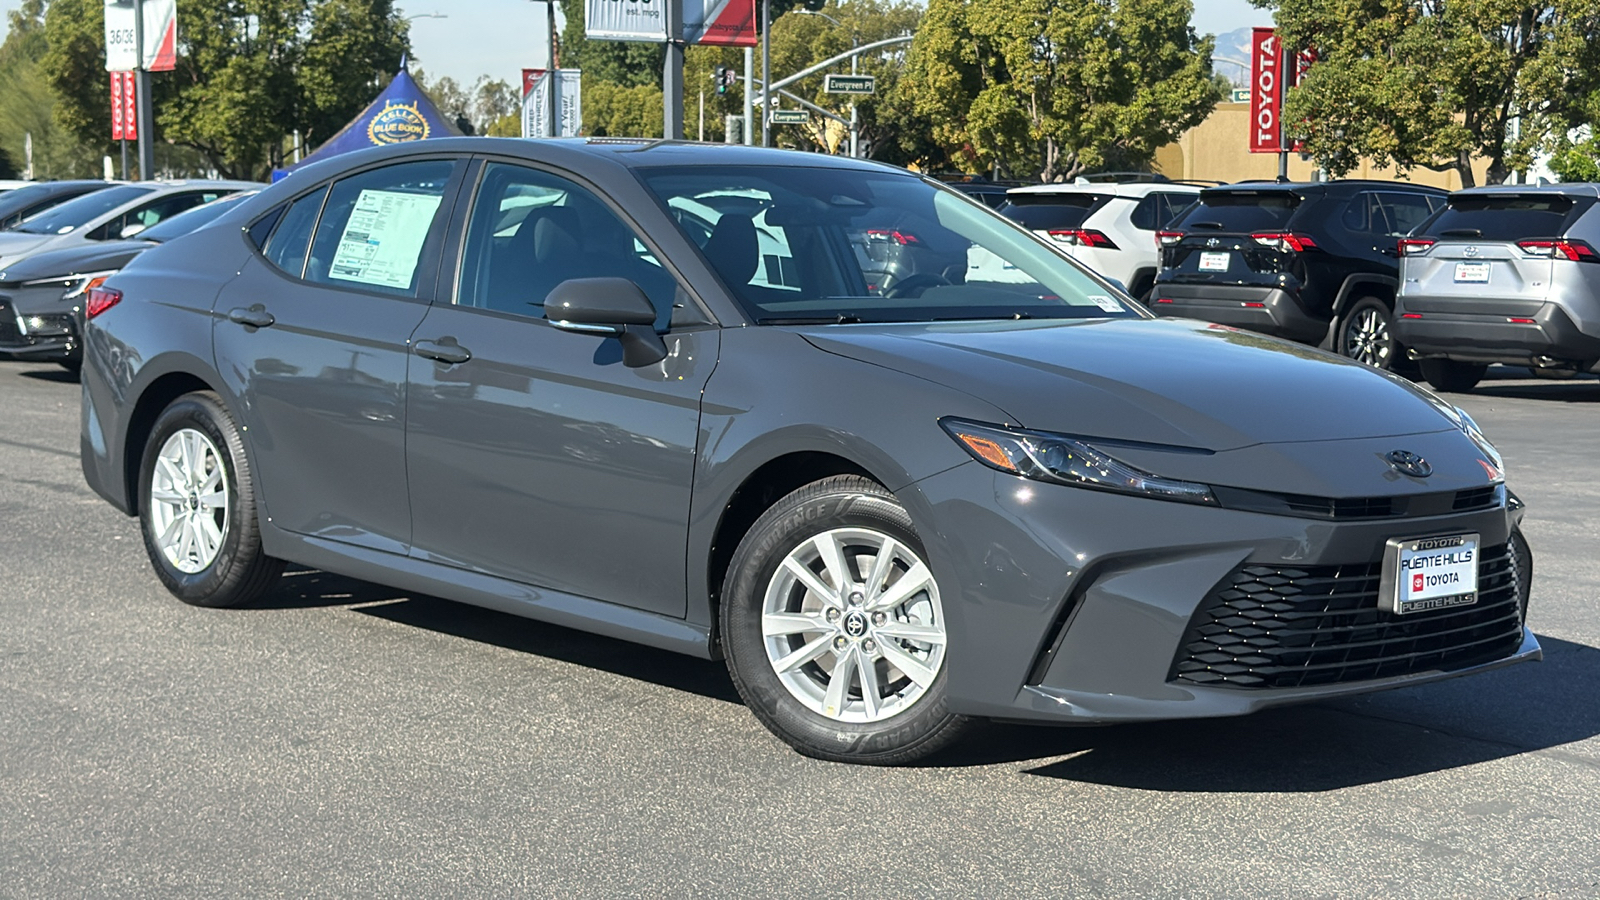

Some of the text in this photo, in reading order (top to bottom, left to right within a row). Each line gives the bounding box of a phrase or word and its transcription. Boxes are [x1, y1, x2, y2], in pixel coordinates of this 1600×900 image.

[642, 9, 659, 19] mpg
[830, 80, 872, 91] Evergreen Pl
[1258, 36, 1275, 146] TOYOTA
[114, 71, 122, 135] TOYOT
[126, 71, 134, 135] TOYOT
[381, 111, 420, 123] KELLEY
[774, 114, 800, 122] Evergreen
[375, 123, 423, 134] BLUE BOOK
[743, 504, 826, 577] ASSURANCE
[1420, 537, 1460, 550] TOYOTA
[1402, 551, 1472, 571] PUENTE HILLS
[1426, 572, 1459, 587] TOYOTA
[1402, 594, 1473, 612] PUENTE HILLS
